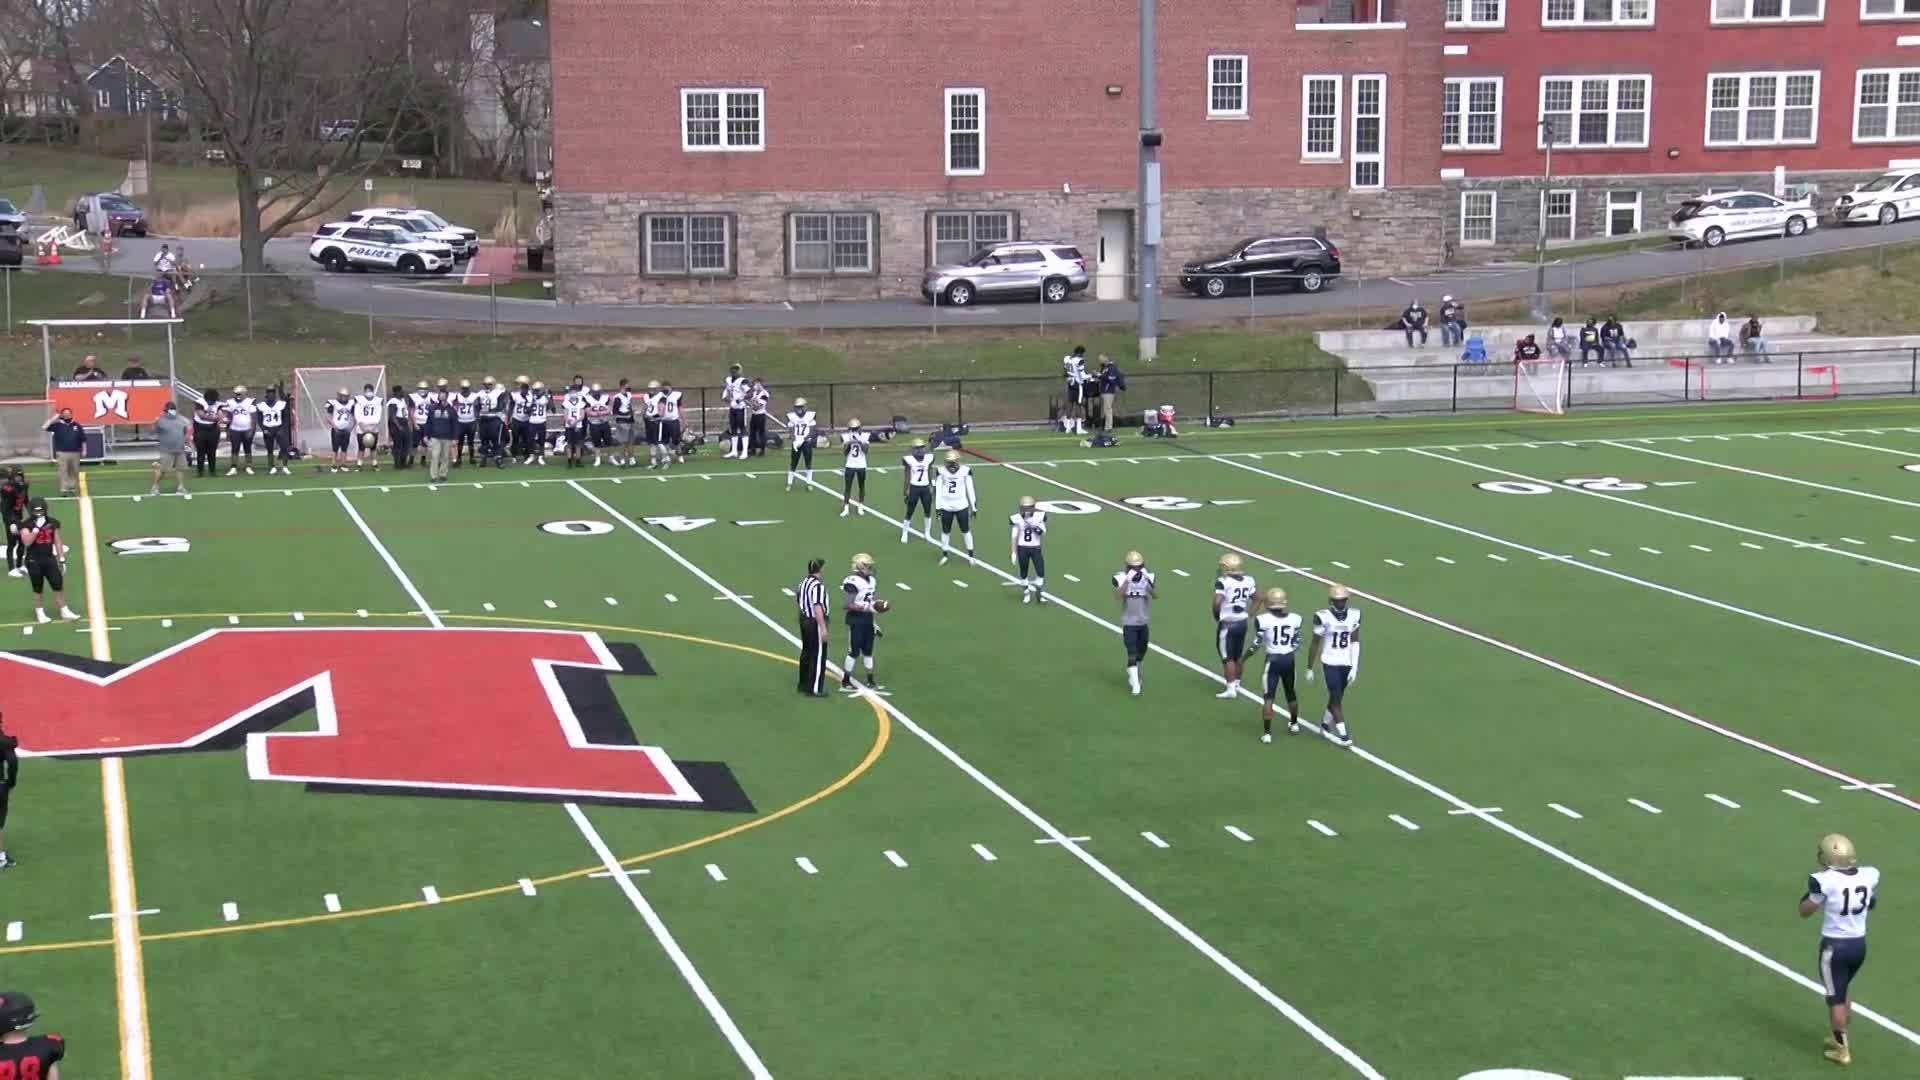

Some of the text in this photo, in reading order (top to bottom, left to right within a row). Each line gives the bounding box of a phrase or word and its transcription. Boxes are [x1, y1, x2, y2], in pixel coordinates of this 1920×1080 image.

[349, 246, 394, 259] POLICE
[93, 389, 129, 419] M
[363, 406, 375, 417] 61
[795, 423, 807, 436] 17
[852, 445, 859, 458] 3
[918, 468, 925, 482] 7
[948, 481, 957, 493] 2
[1024, 527, 1032, 542] 8
[1273, 625, 1290, 646] 15
[1332, 631, 1349, 648] 18
[1840, 886, 1867, 916] 13
